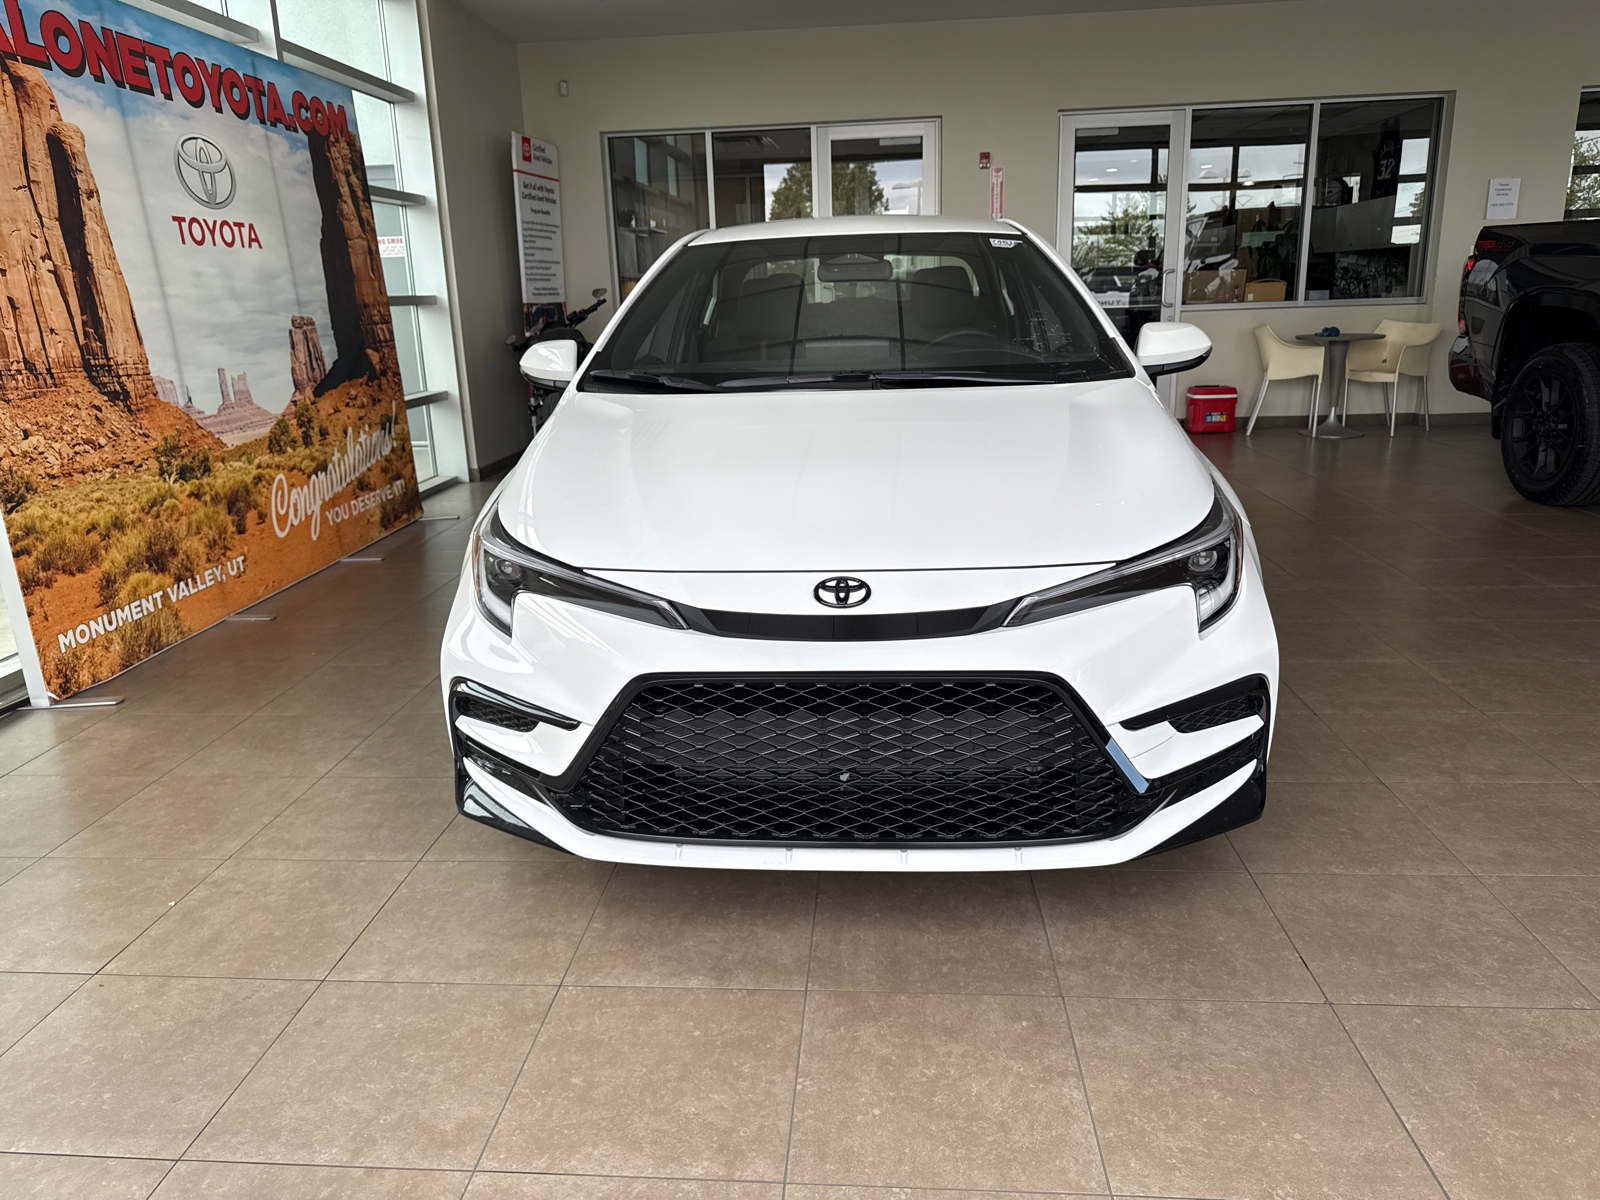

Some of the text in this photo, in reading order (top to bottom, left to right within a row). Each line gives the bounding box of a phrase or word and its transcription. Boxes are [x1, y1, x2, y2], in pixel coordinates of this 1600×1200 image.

[1377, 158, 1396, 181] 32
[172, 215, 263, 250] TOYOTA
[1478, 240, 1496, 250] TRD
[270, 400, 398, 541] Congratulations!
[326, 479, 407, 527] YOU DESERVE IT!
[57, 555, 246, 653] MONUMENT VALLEY, UT
